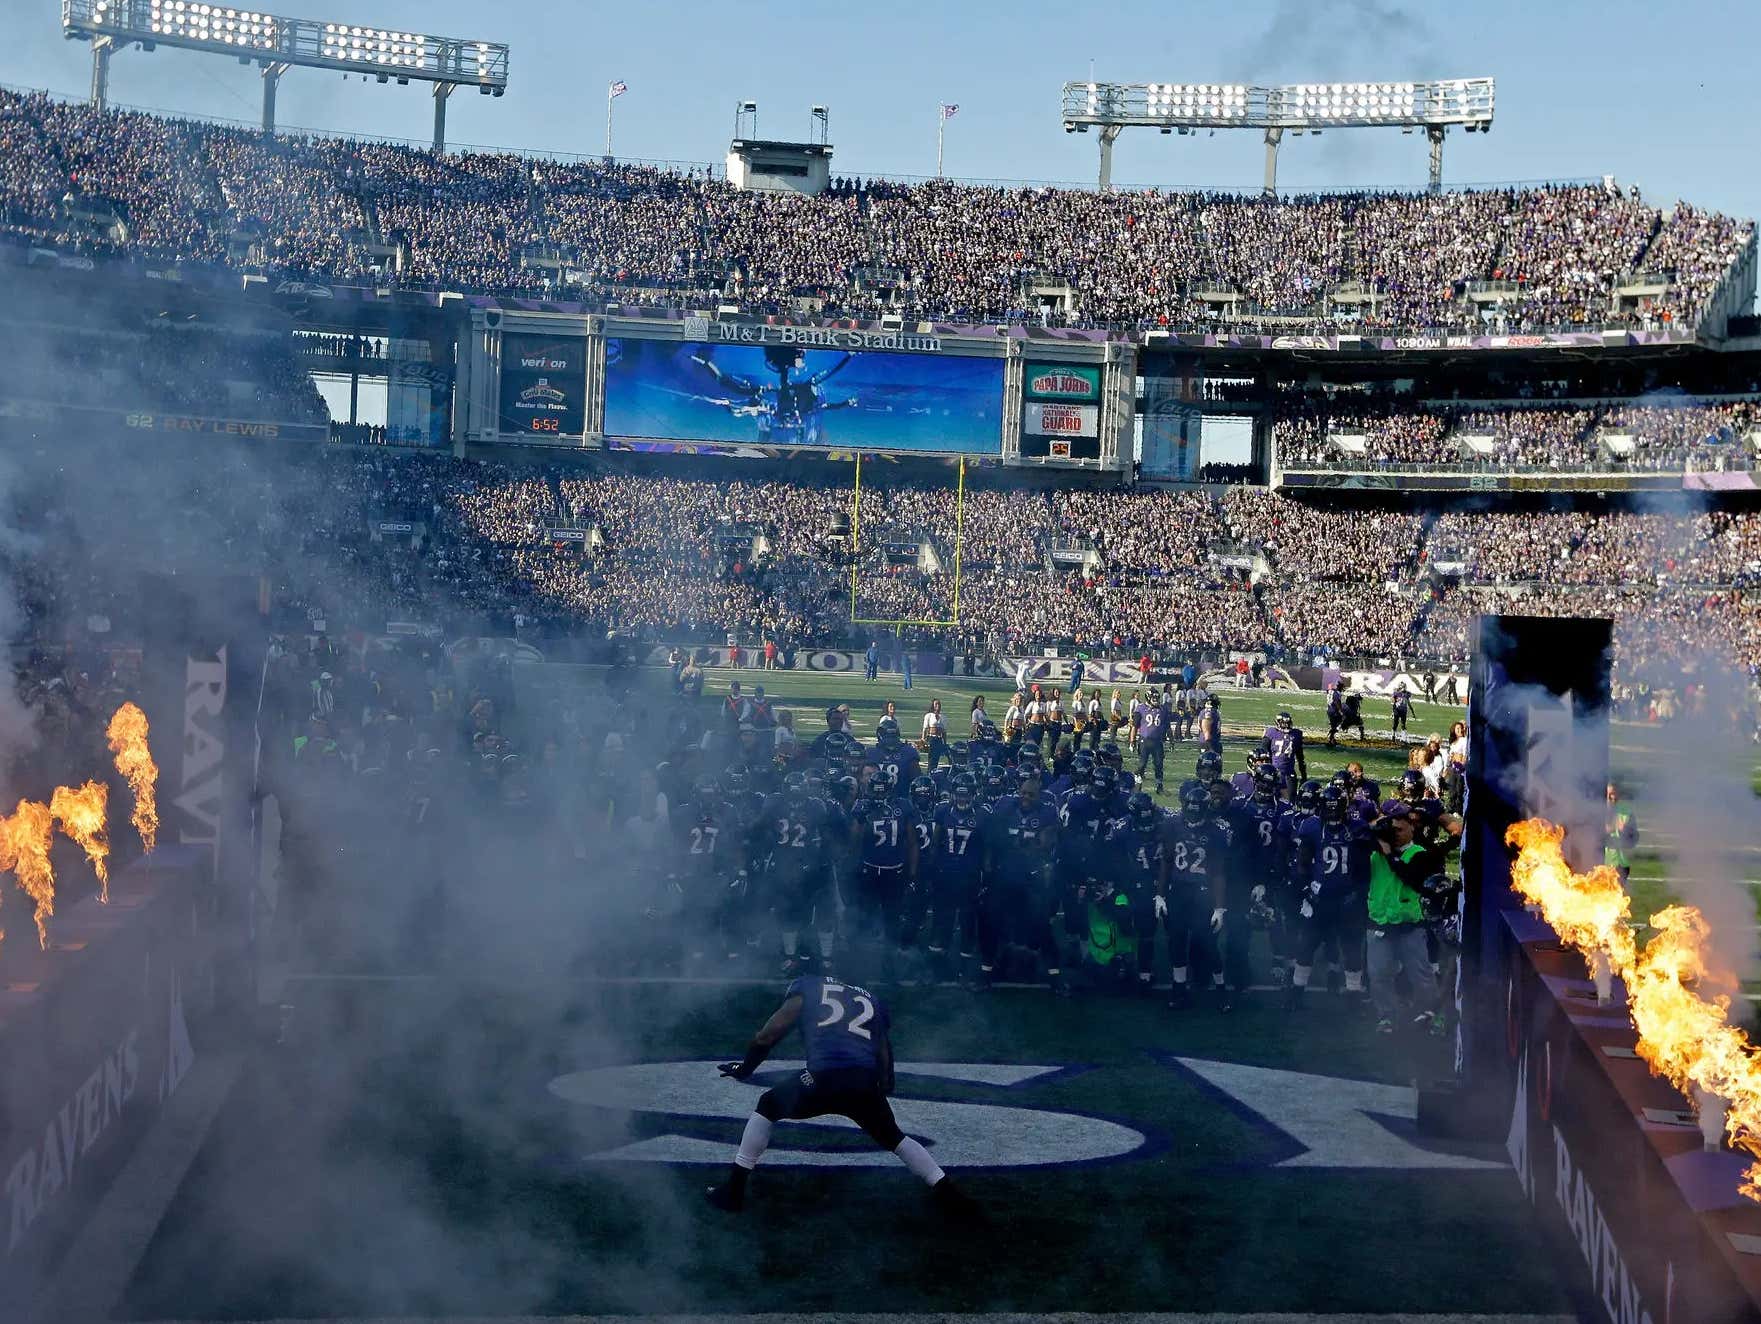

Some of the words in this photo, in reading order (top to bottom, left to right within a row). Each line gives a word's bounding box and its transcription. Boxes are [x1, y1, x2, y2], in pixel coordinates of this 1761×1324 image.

[718, 323, 770, 342] M&T
[780, 326, 839, 346] Bank
[847, 330, 942, 351] Stadium
[521, 357, 567, 369] verizon
[1034, 377, 1058, 391] PAPA
[164, 417, 204, 431] RAY
[213, 421, 279, 437] LEWIS
[533, 418, 558, 430] 6:52
[1042, 416, 1082, 430] GUARD
[380, 523, 411, 531] GEICO
[553, 531, 584, 540] GEICO
[1053, 552, 1083, 561] GEICO
[1145, 714, 1160, 727] 96
[689, 827, 718, 855] 27
[777, 818, 806, 847] 32
[873, 820, 898, 848] 51
[948, 828, 973, 855] 17
[1174, 842, 1206, 874] 82
[1322, 847, 1348, 874] 91
[817, 984, 875, 1040] 52
[5, 1024, 139, 1257] RAVENS
